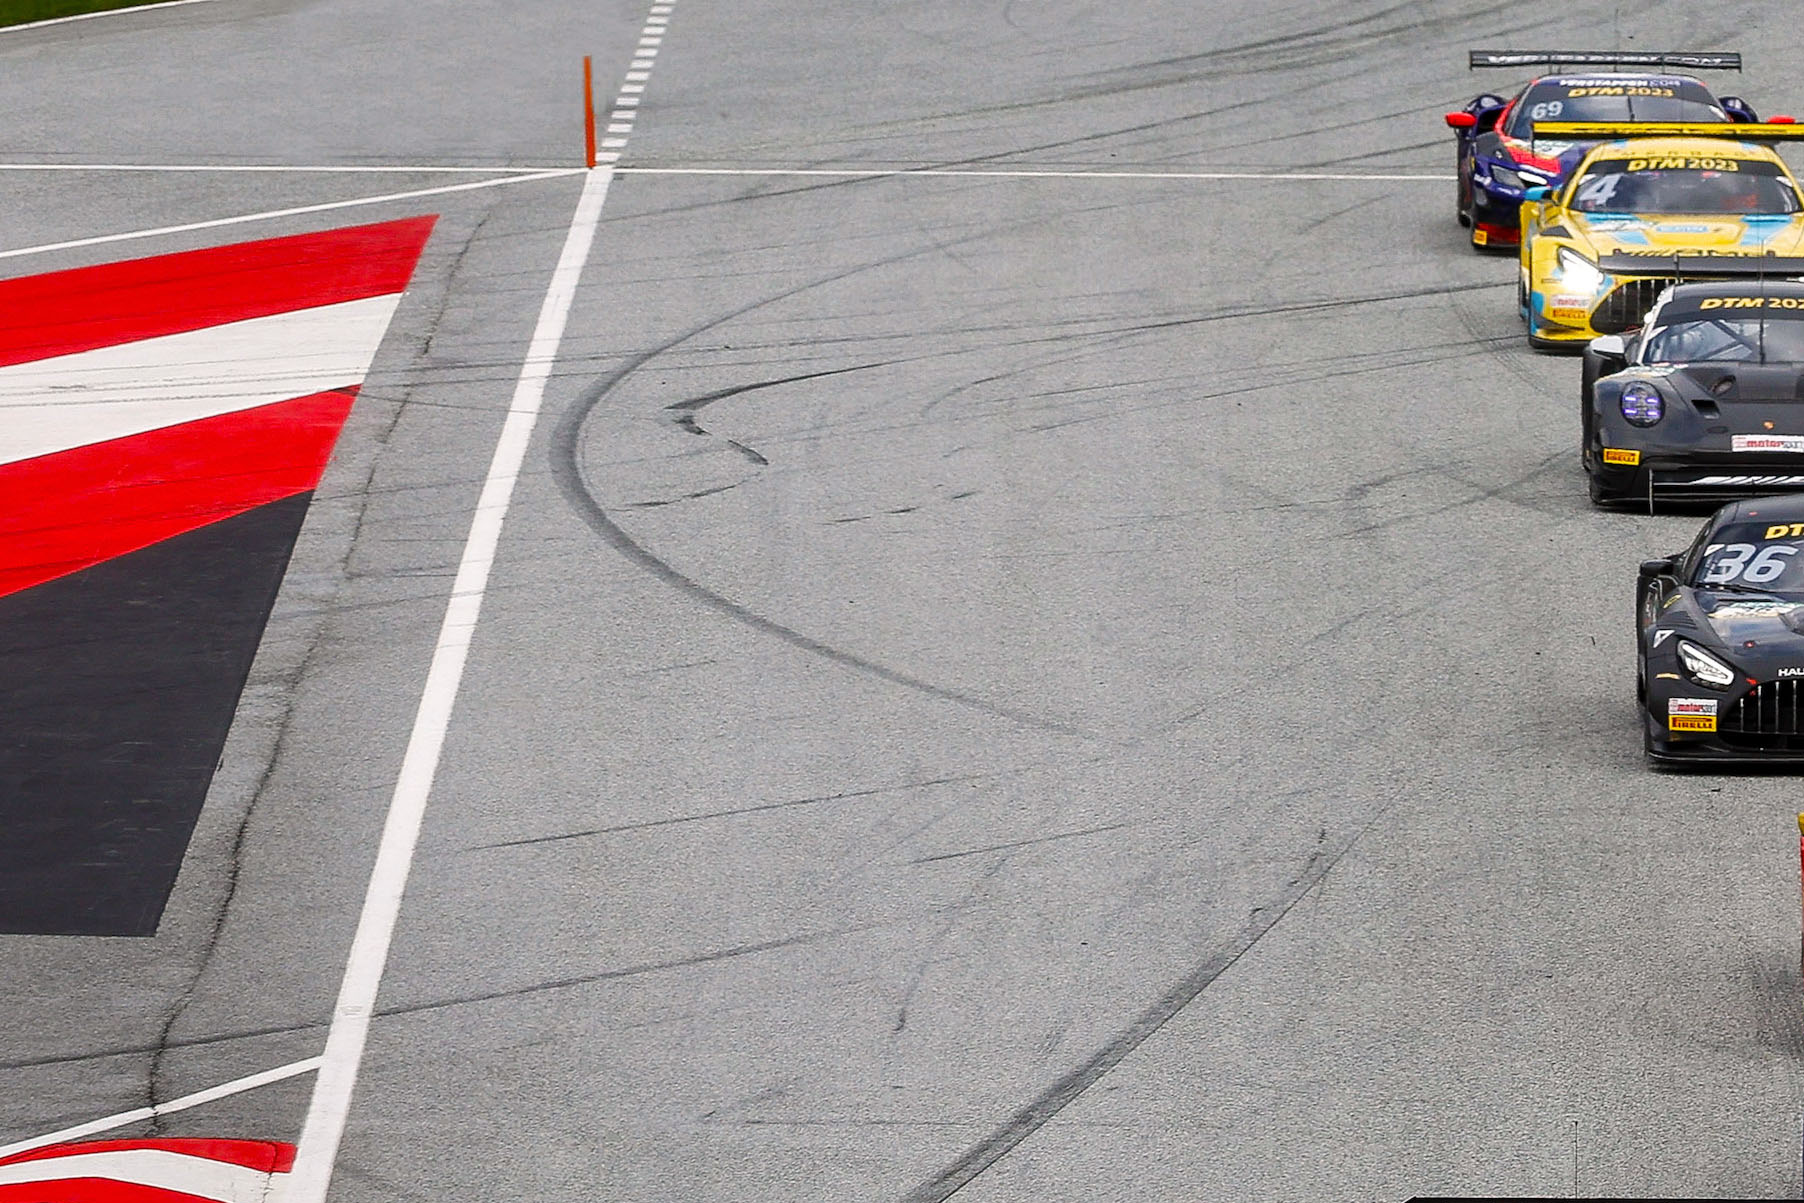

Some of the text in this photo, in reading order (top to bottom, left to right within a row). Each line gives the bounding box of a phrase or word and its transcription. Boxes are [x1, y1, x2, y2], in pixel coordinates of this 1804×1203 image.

[1568, 86, 1674, 98] DTM 2023
[1531, 101, 1563, 121] 69
[1627, 158, 1740, 172] DTM 2023
[1580, 173, 1624, 207] 4
[1699, 297, 1766, 311] DTM
[1703, 543, 1798, 584] 36
[1670, 716, 1715, 731] PIRELLI
